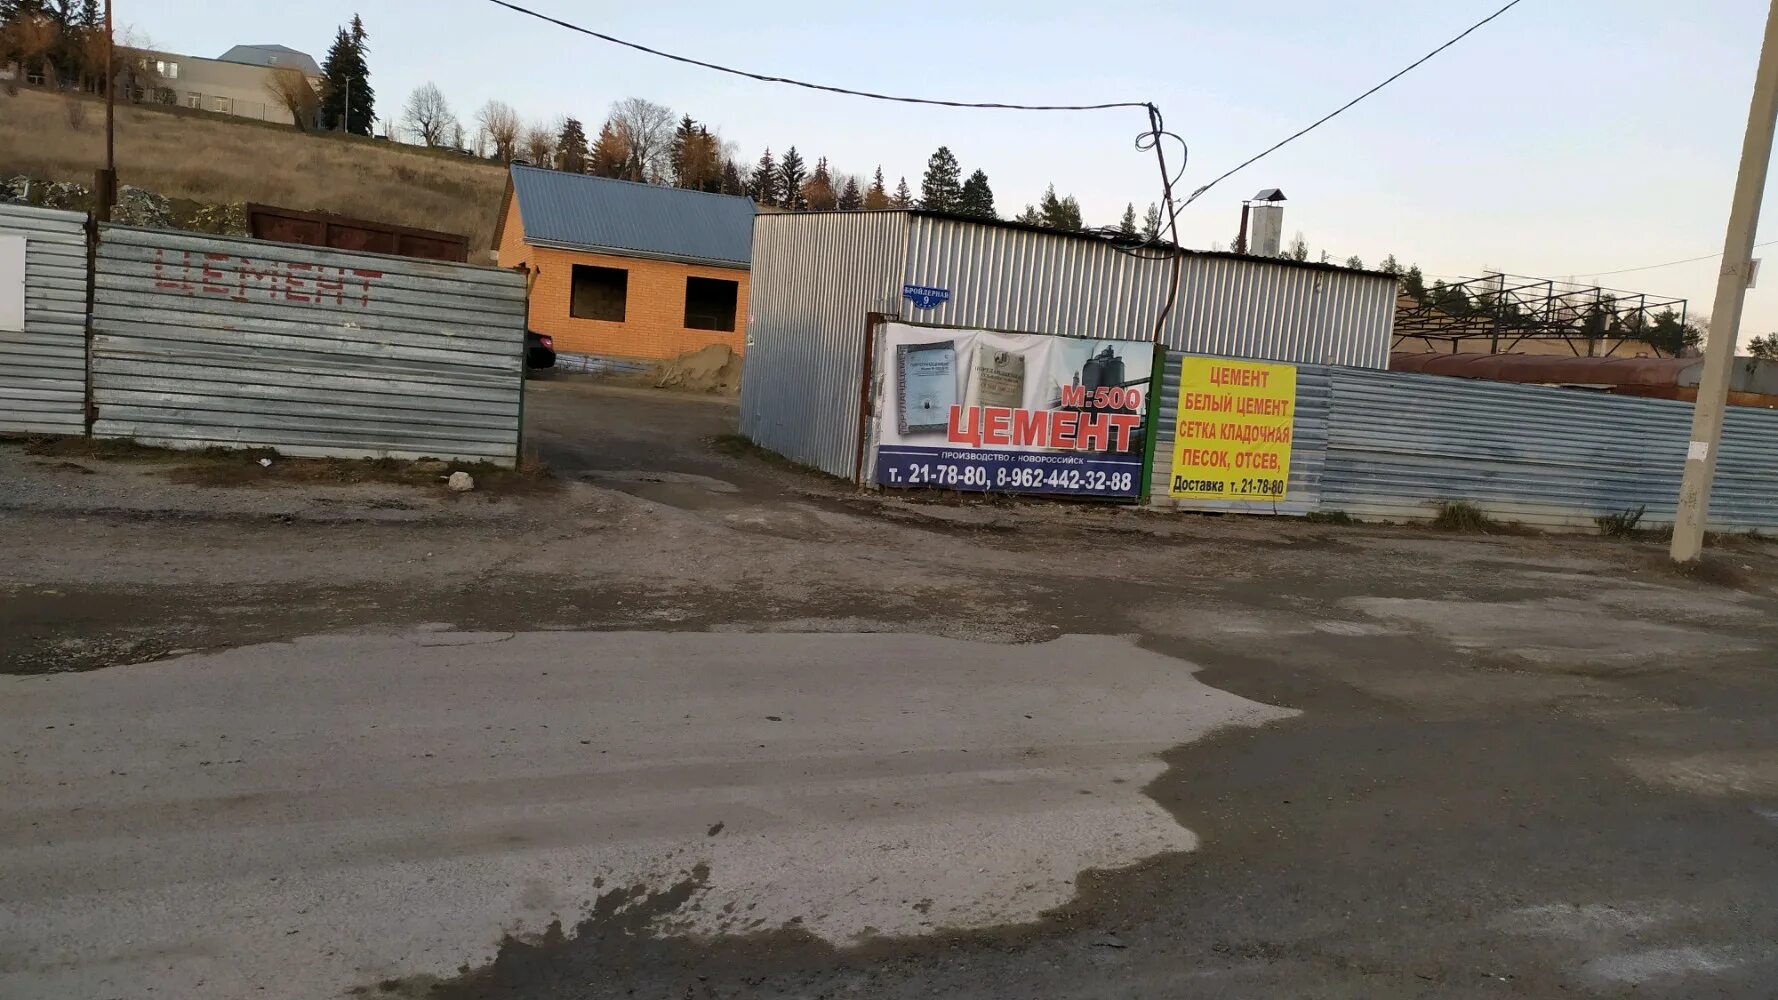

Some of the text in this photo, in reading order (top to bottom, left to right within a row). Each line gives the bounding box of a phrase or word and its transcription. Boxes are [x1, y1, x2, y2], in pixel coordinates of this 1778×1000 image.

[155, 248, 384, 308] ЦЕМЕНТ
[904, 286, 949, 298] БРОЙЛЕРНАЯ
[923, 296, 930, 305] 9
[1210, 366, 1270, 388] ЦЕМЕНТ
[1061, 384, 1141, 410] М:500
[1185, 392, 1289, 417] БЕЛЫЙ ЦЕМЕНТ
[948, 404, 1141, 452] ЦЕМЕНТ
[1179, 420, 1289, 444] СЕТКА КЛАДОЧНАЯ
[941, 451, 1009, 461] ПРОИЗВОДСТВО
[1018, 455, 1084, 464] НОВОРОССИЙСК
[1182, 448, 1281, 473] ПЕСОК, ОТСЕВ,
[888, 463, 1132, 491] т. 21-78-80, 8-962-442-32-88
[1173, 475, 1284, 494] Доставка т. 21-78-80
